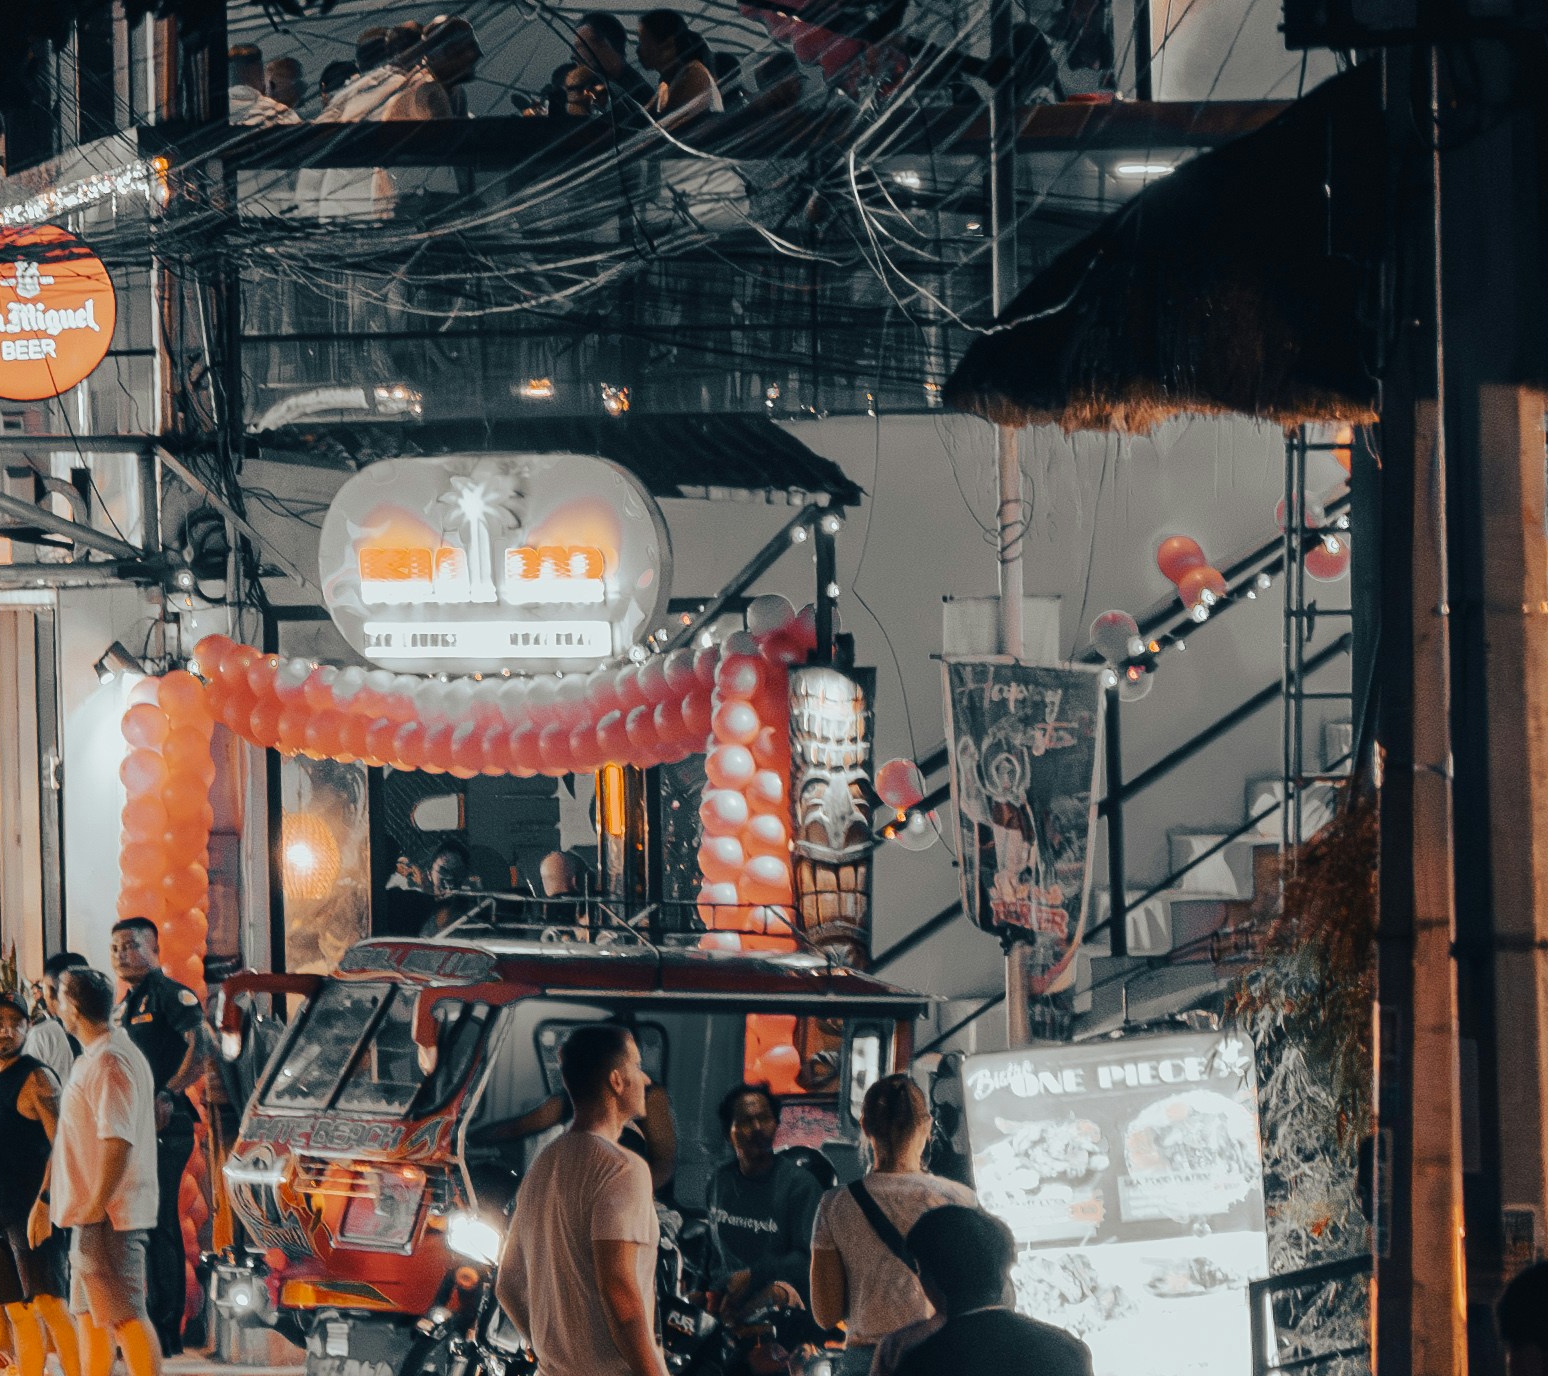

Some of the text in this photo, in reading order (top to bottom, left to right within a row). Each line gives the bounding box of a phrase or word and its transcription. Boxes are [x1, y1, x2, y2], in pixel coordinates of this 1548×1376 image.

[5, 298, 101, 336] Miguel
[0, 338, 57, 361] BEER
[1097, 1056, 1208, 1089] PIECE
